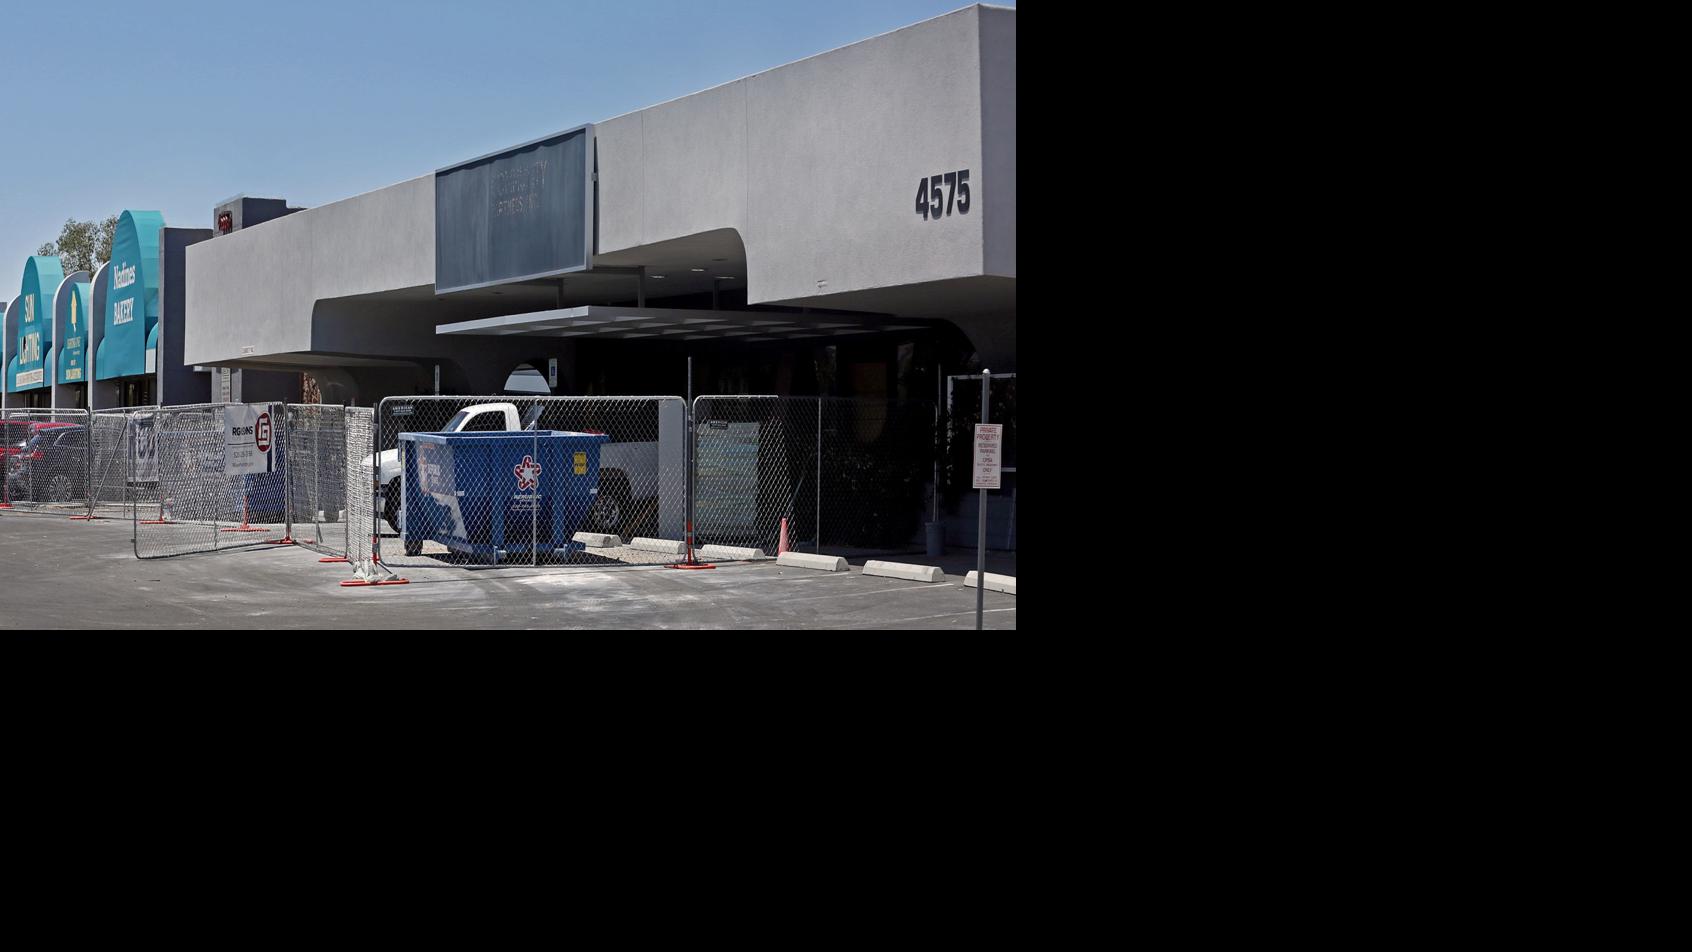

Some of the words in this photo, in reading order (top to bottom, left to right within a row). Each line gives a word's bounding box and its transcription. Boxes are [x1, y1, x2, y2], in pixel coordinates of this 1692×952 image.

[916, 169, 970, 221] 4575
[113, 261, 136, 290] Nadines
[24, 293, 35, 323] SUN
[113, 297, 135, 325] BAKERY
